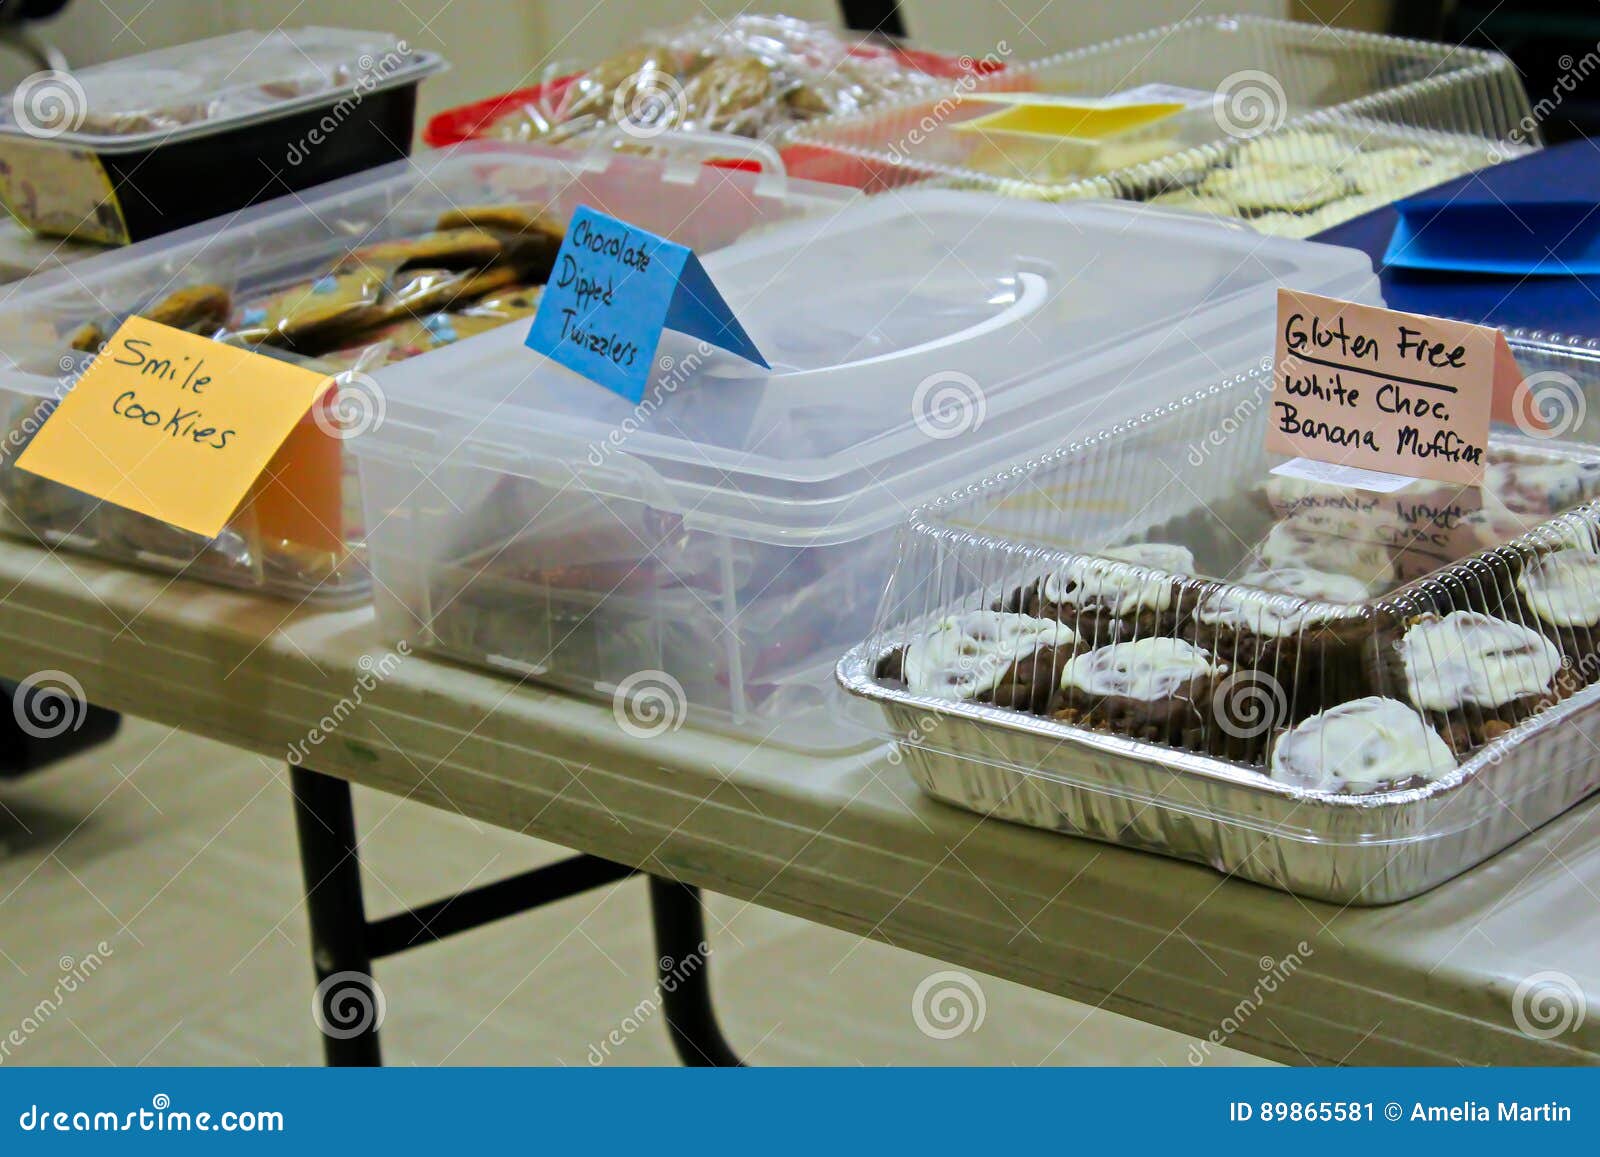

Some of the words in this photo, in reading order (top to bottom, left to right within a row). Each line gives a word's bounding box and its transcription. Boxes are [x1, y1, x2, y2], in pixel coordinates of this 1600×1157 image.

[572, 219, 651, 273] Chocolate
[556, 253, 613, 311] Dipped
[560, 308, 639, 366] Twizzlers
[1285, 313, 1379, 361] Gluten
[1397, 326, 1466, 369] Free
[114, 339, 212, 394] Smile
[1274, 401, 1380, 452] Banana
[1376, 384, 1451, 421] Choc.
